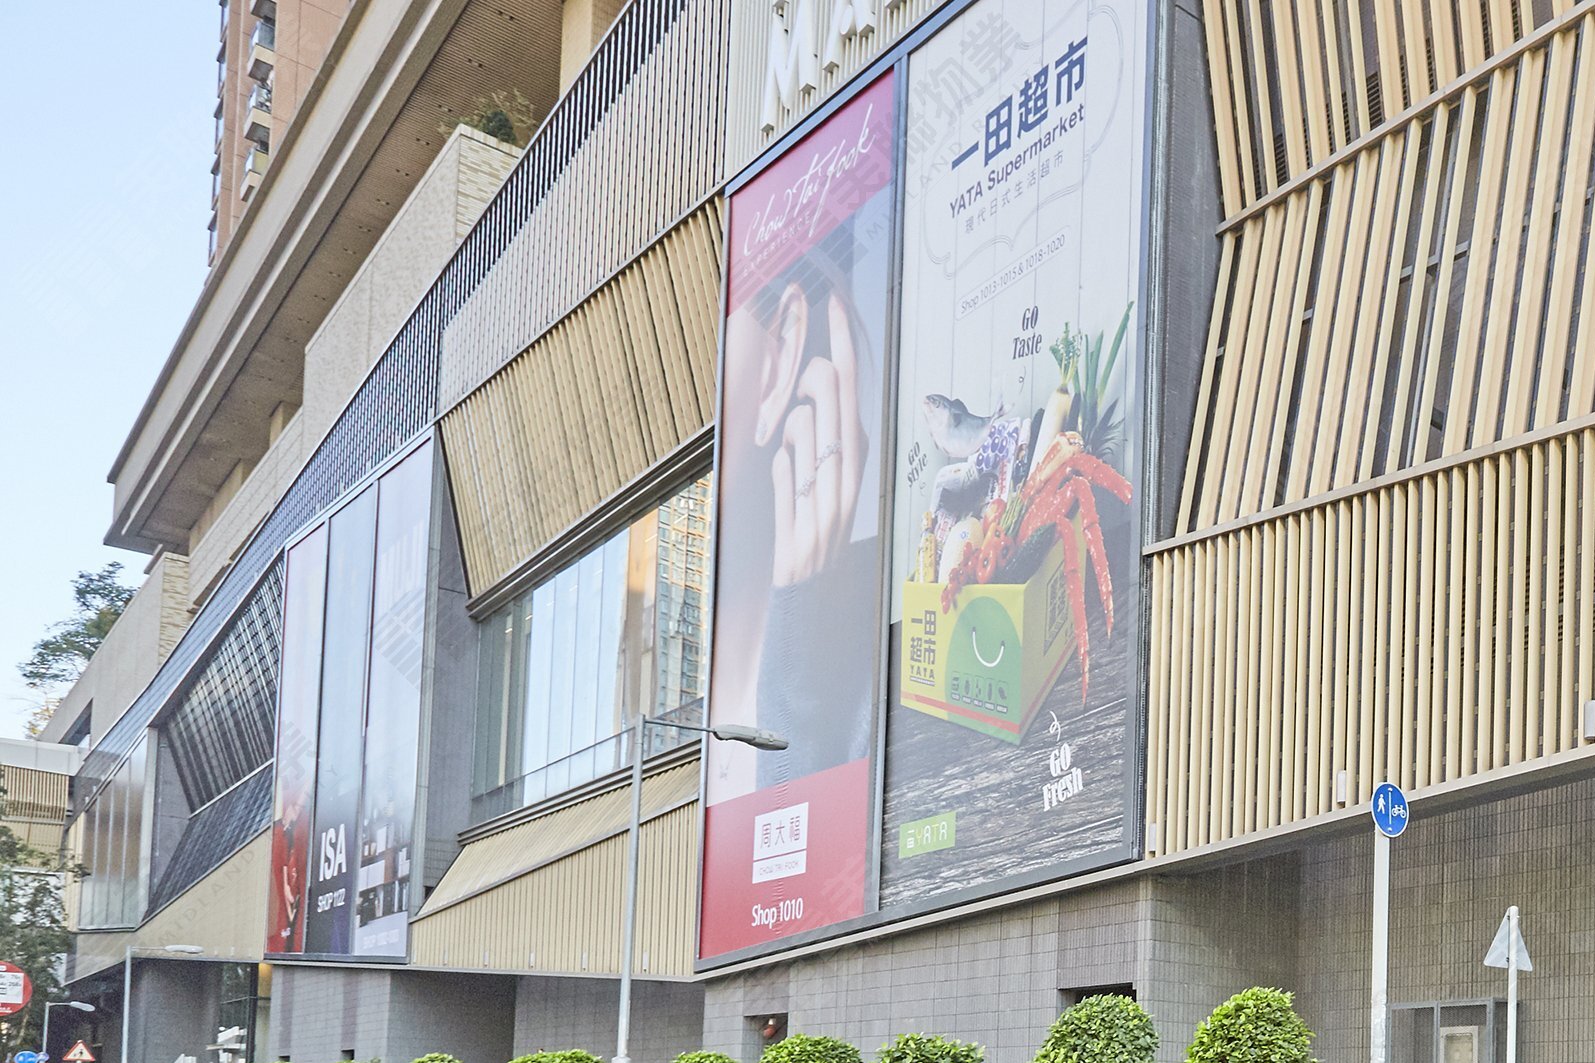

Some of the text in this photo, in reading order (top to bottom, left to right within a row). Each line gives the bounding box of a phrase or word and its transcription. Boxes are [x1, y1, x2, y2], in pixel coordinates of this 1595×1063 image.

[951, 35, 1088, 170] 一田超市
[950, 103, 1084, 219] YATA Supermarket
[964, 150, 1064, 234] 現代日式生活超市
[961, 233, 1066, 315] Shop 1013-1015 & 1018-1020
[1021, 305, 1039, 332] GO
[1012, 333, 1042, 360] Taste
[911, 610, 936, 636] 一田
[910, 637, 936, 665] 超市
[910, 664, 936, 680] YATA
[1050, 743, 1072, 777] GO
[760, 815, 801, 849] 周大福
[319, 824, 347, 882] ISA
[751, 897, 803, 930] Shop 1010
